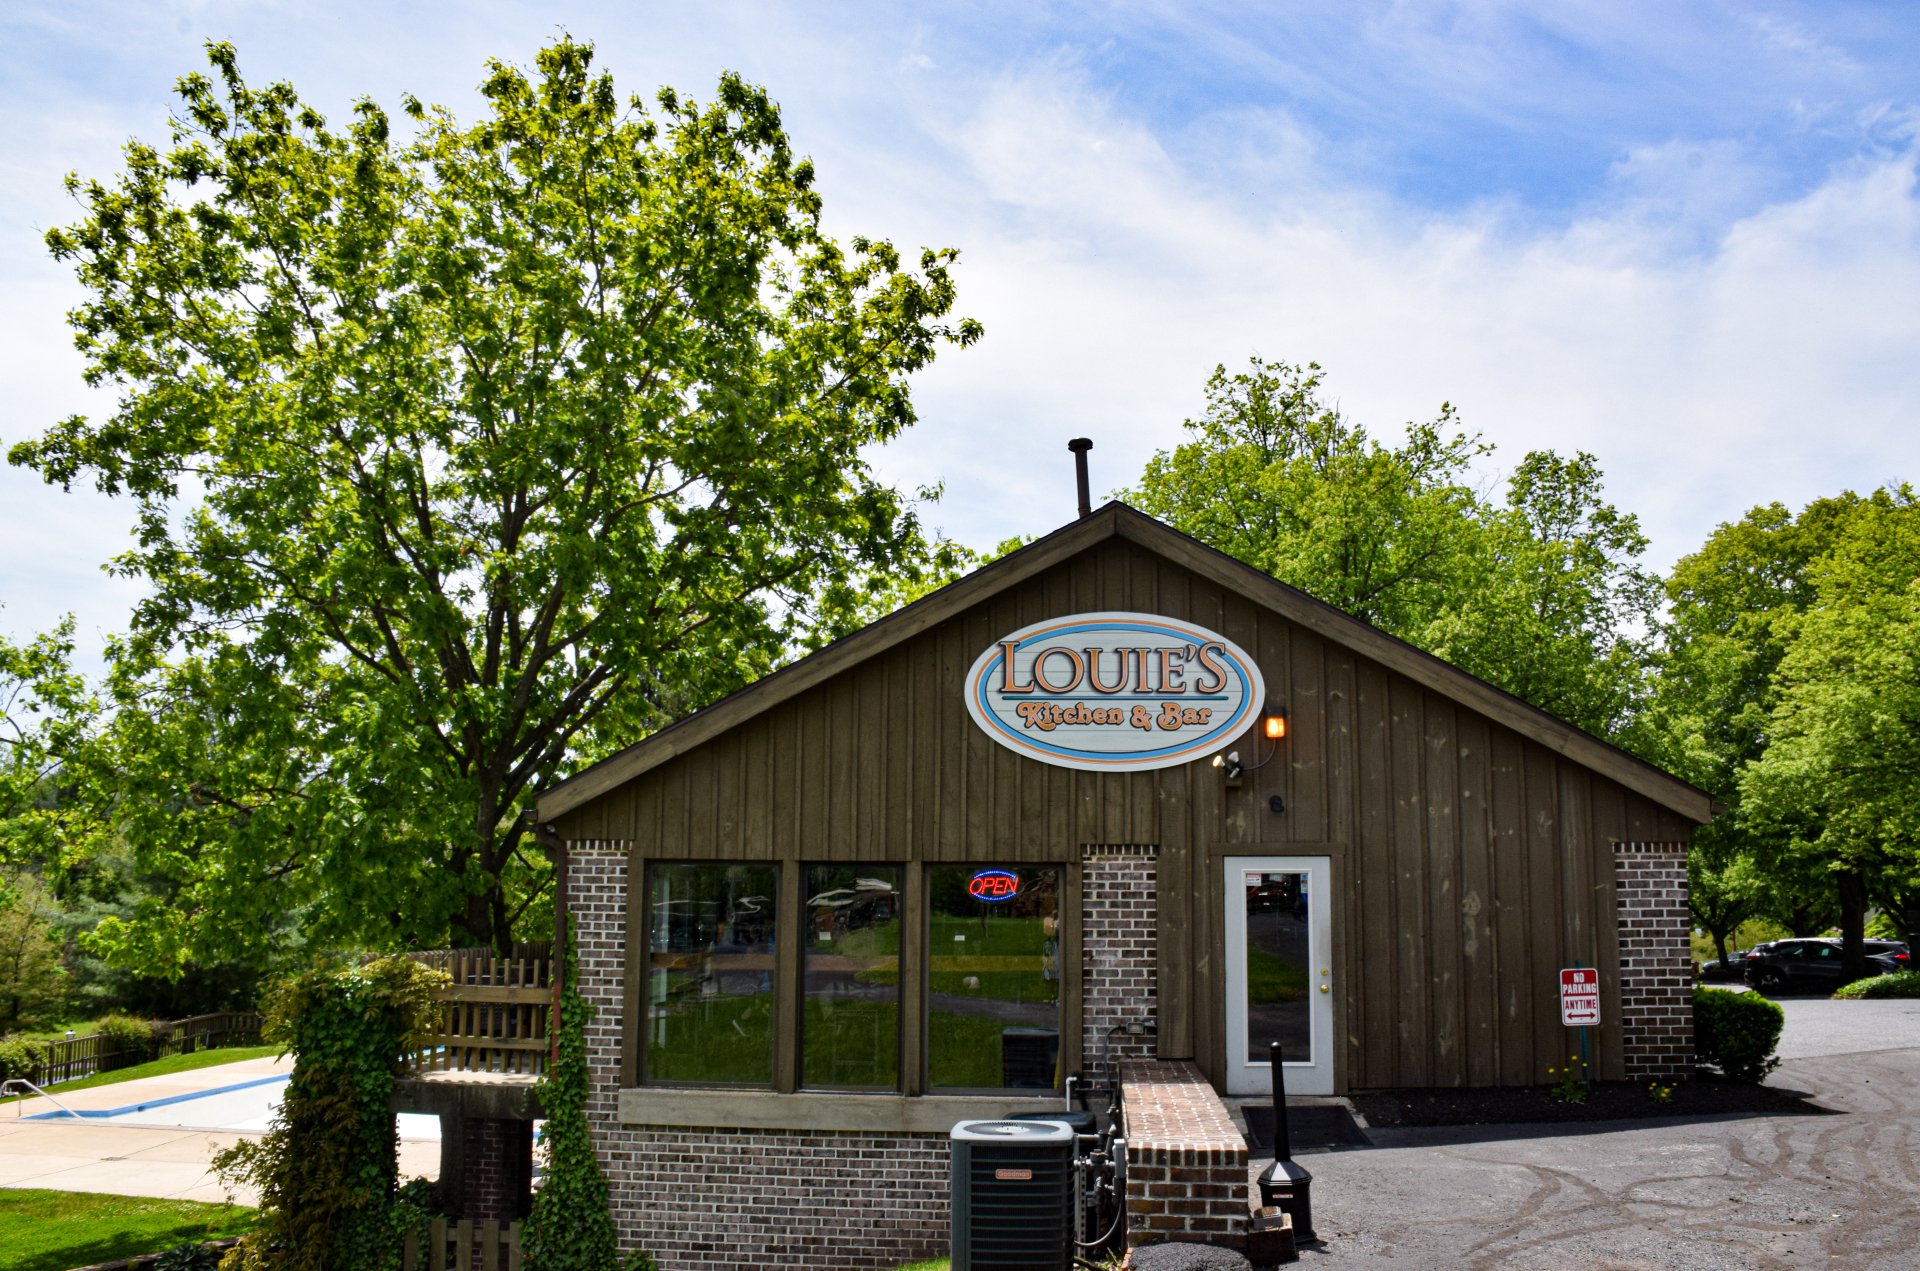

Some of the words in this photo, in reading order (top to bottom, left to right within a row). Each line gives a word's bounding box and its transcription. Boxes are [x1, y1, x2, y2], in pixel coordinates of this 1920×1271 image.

[998, 640, 1228, 694] LOUIE'S
[1016, 702, 1124, 731] Kitchen
[1130, 705, 1152, 731] &
[1156, 702, 1213, 731] Bar
[969, 876, 1019, 895] OPEN
[1573, 972, 1585, 983] NO
[1563, 983, 1597, 994] PARKING
[1565, 999, 1597, 1010] ANYTIME
